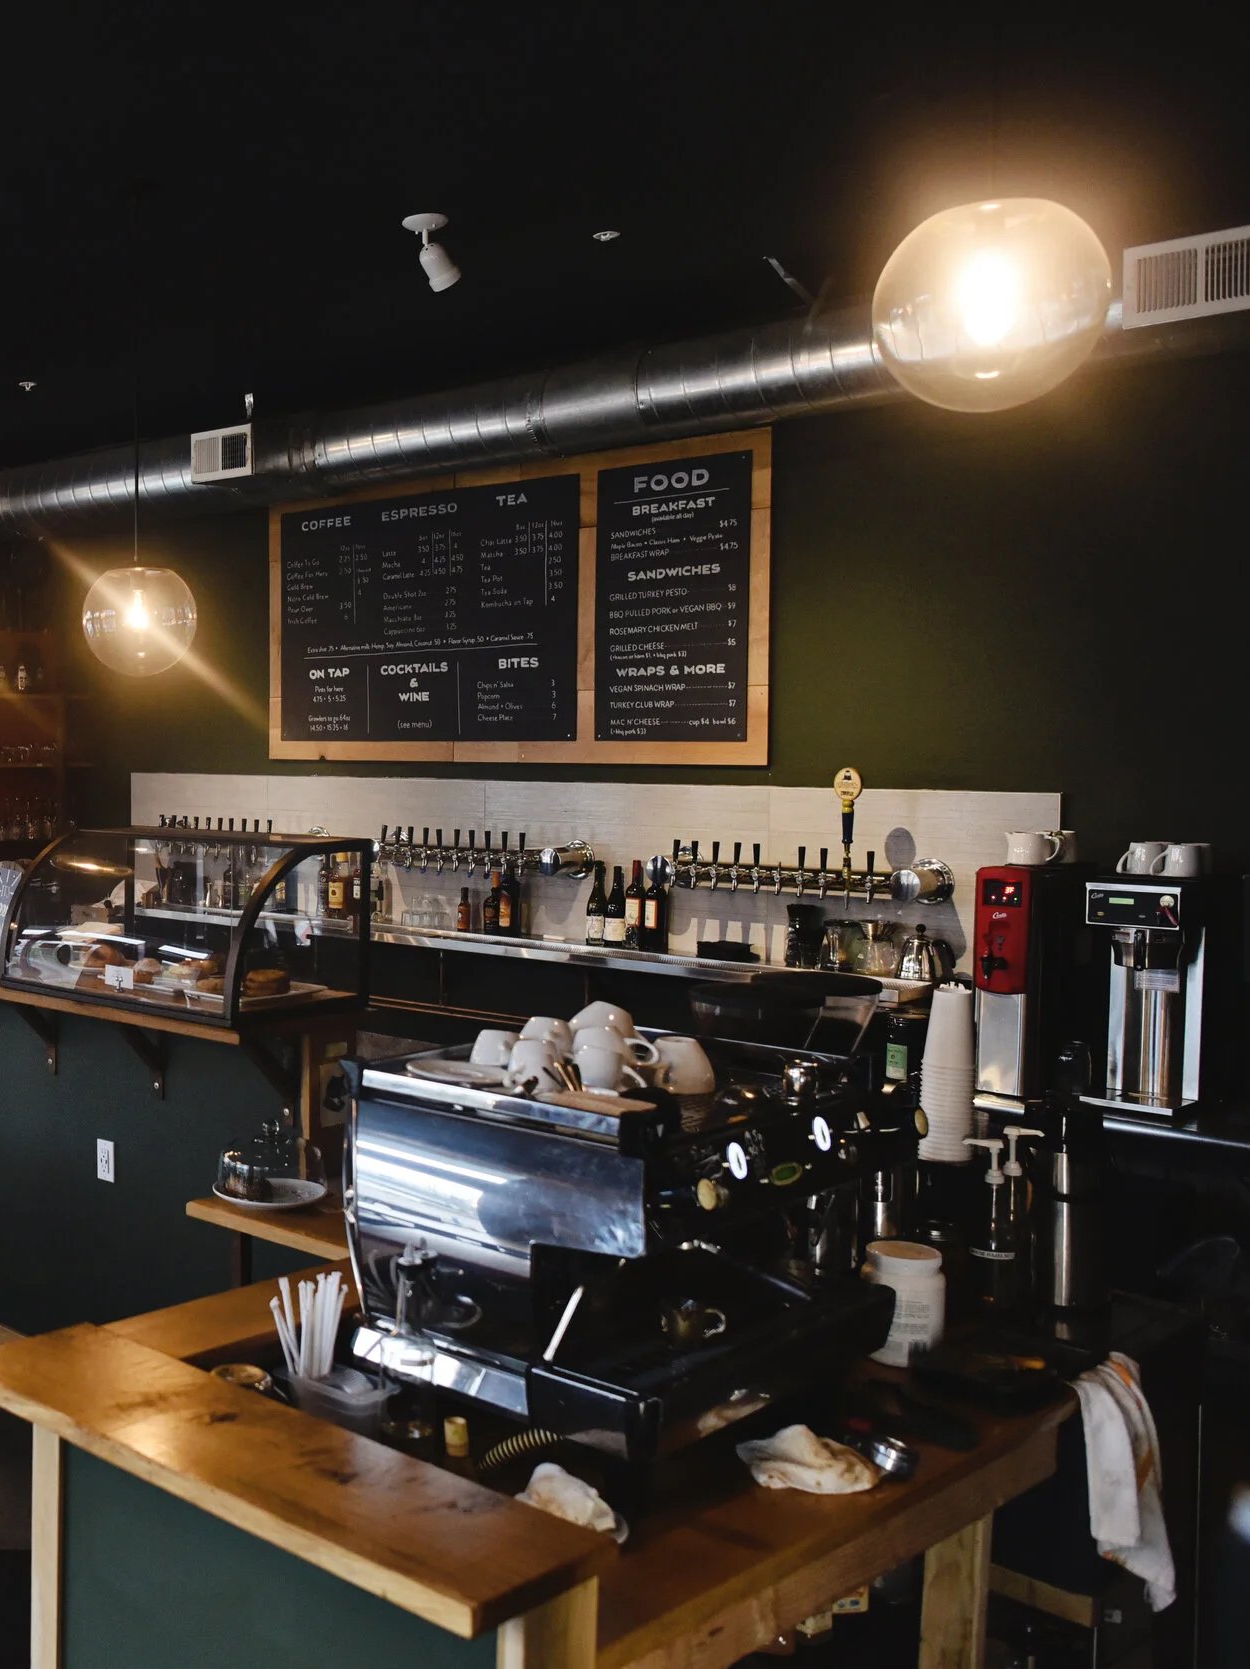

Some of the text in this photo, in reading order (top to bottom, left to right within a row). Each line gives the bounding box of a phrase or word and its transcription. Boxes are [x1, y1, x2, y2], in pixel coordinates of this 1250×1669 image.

[634, 468, 710, 493] FOOD
[496, 492, 528, 506] TEA
[381, 502, 458, 521] ESPRESSO
[632, 497, 716, 516] BREAKFAST
[301, 516, 351, 531] COFFEE
[610, 527, 656, 540] SANDWICHES
[610, 550, 648, 561] BREAKFAST
[649, 548, 670, 557] WRAP
[492, 574, 503, 582] Pot
[628, 563, 721, 581] SANDWICHES
[609, 593, 638, 601] GRILLED
[638, 590, 664, 599] TURKEY
[666, 588, 687, 597] PESTO
[481, 600, 512, 608] Kombucha
[523, 597, 534, 606] Tap
[609, 610, 623, 619] BBQ
[625, 609, 650, 617] PULLED
[652, 607, 671, 615] PORK
[680, 604, 704, 613] VEGAN
[706, 602, 722, 611] BBQ
[727, 602, 736, 610] $9
[609, 619, 737, 636] ROSEMARY CHICKEN MELT $7
[610, 638, 736, 652] GRILLED CHEESE $5
[380, 662, 448, 675] COCKTAILS
[498, 657, 539, 669] BITES
[309, 668, 350, 680] ON TAP
[616, 663, 726, 677] WRAPS & MORE
[410, 678, 418, 688] &
[477, 681, 492, 691] Chips
[609, 682, 736, 693] VEGAN SPINACH WRAP $7
[398, 691, 430, 702] WINE
[477, 692, 500, 702] Popcorn
[505, 702, 523, 710] Olives
[610, 701, 634, 709] TURKEY
[654, 700, 675, 708] WRAP
[397, 719, 432, 730] (see menu)
[610, 718, 626, 726] MAC
[689, 719, 700, 727] cup
